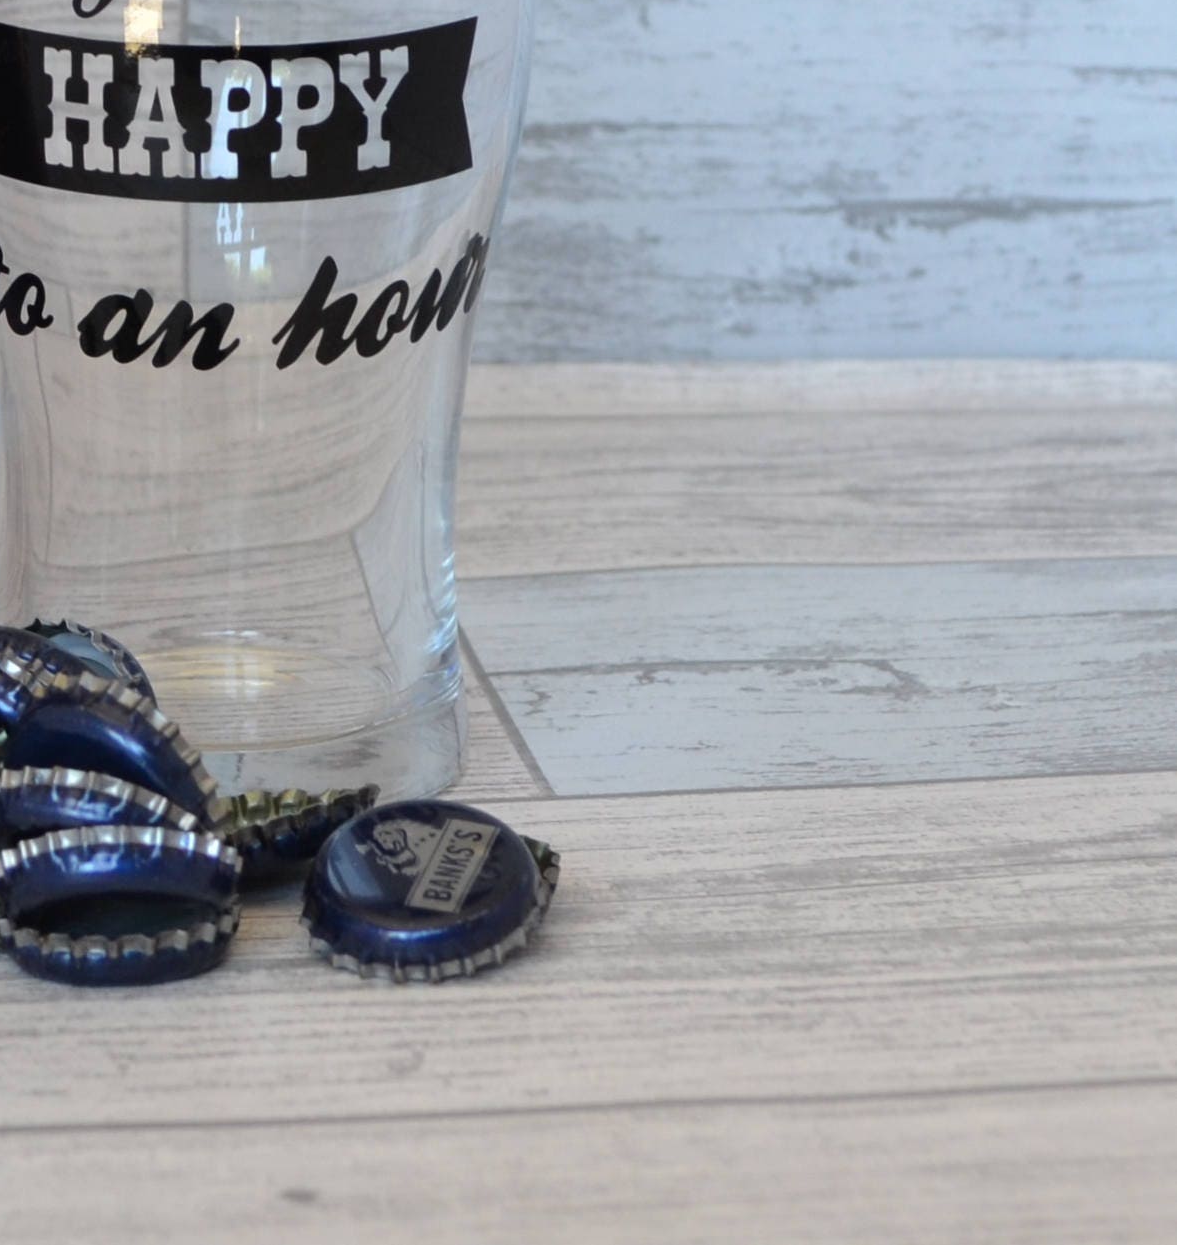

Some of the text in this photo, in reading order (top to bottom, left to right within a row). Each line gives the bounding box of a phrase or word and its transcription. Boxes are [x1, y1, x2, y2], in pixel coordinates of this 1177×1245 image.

[42, 44, 410, 180] HAPPY
[77, 288, 241, 371] an
[424, 828, 483, 903] BANKS'S
